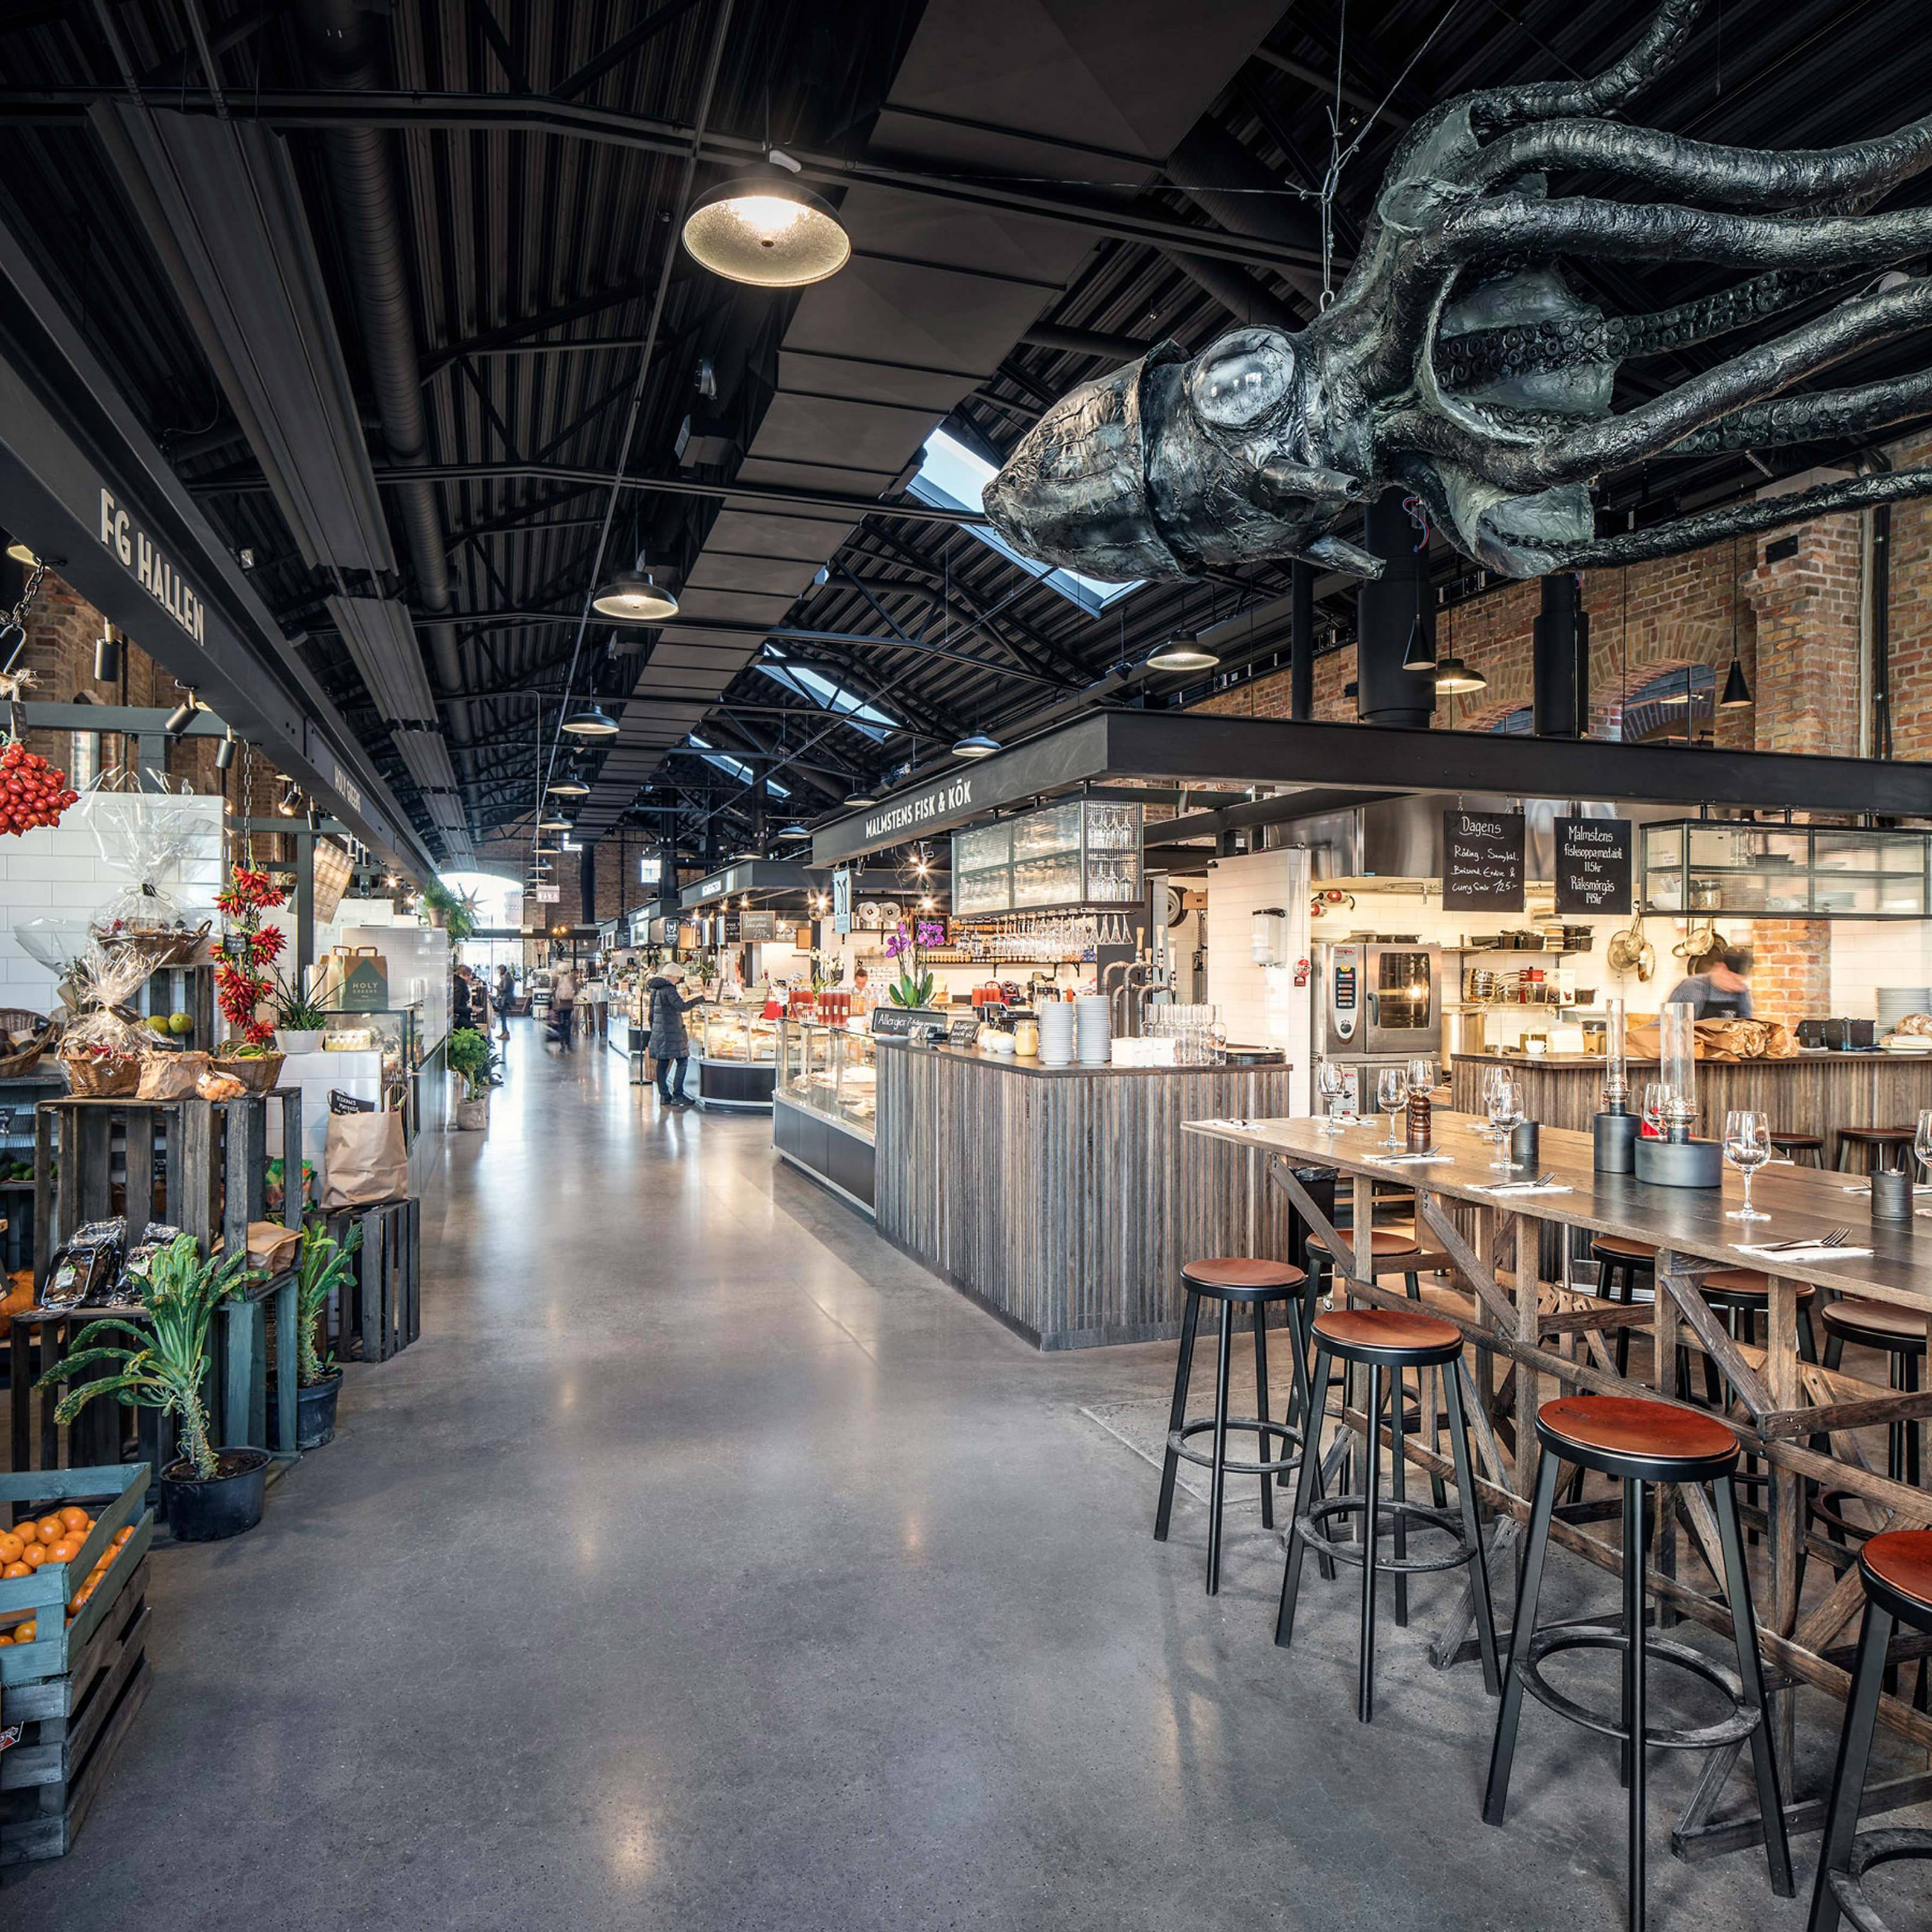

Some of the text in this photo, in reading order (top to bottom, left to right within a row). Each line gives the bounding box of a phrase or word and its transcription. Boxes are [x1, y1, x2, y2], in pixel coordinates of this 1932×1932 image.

[101, 488, 204, 647] FG HALLEN
[865, 778, 971, 839] MALMSTENS FISK & KÖK
[1460, 816, 1502, 837] Dagens
[1569, 825, 1613, 842] Malmstens
